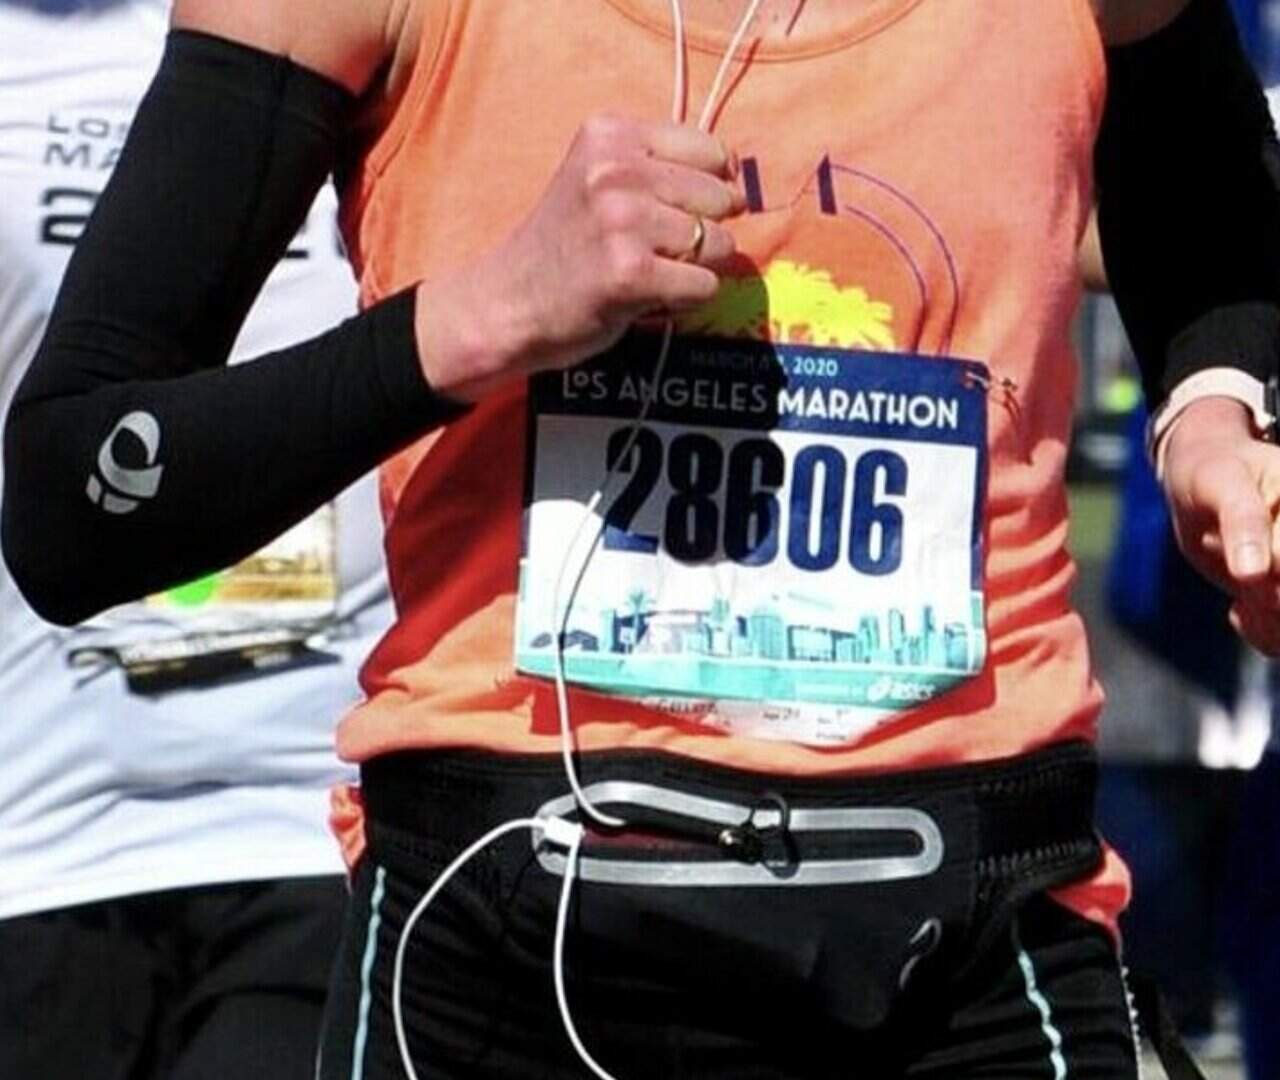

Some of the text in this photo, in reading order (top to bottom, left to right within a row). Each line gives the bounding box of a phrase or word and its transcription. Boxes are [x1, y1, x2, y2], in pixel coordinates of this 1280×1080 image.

[792, 356, 839, 377] 2020
[618, 376, 768, 413] ANGELES
[776, 387, 959, 430] MARATHON
[601, 427, 908, 576] 28606
